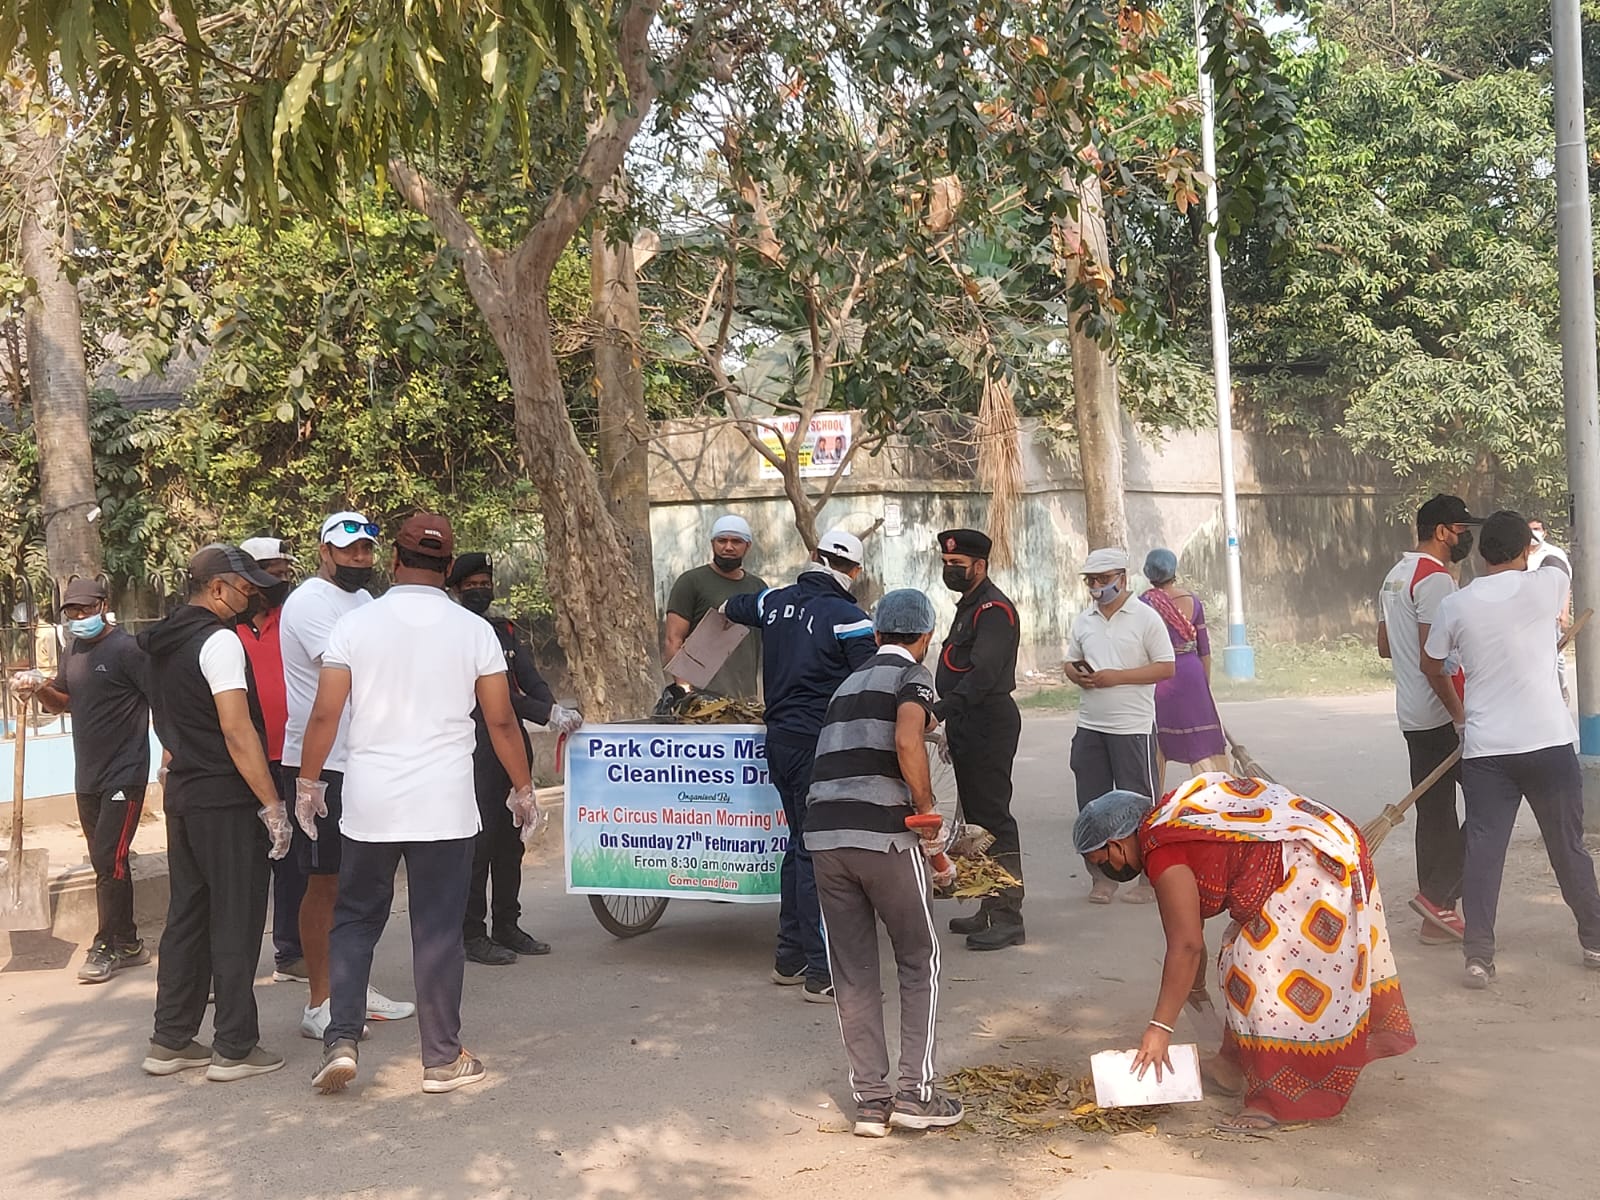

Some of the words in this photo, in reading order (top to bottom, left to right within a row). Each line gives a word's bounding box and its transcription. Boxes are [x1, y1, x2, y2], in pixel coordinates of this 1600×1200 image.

[811, 419, 844, 432] SCHOOL
[589, 739, 642, 758] Park
[650, 739, 725, 759] Circus
[607, 765, 734, 784] Cleanliness
[677, 791, 717, 803] Organised
[578, 807, 609, 823] Park
[613, 807, 658, 824] Circus
[662, 808, 712, 825] Maidan
[716, 810, 772, 831] Morning
[600, 833, 618, 848] On
[621, 834, 673, 850] Sunday
[676, 831, 703, 850] 27th
[705, 836, 768, 854] February,
[634, 856, 667, 868] From
[671, 857, 698, 869] 8:30
[701, 860, 719, 870] am
[721, 860, 776, 872] onwards
[669, 875, 698, 886] Come
[702, 878, 719, 888] and
[720, 877, 738, 889] Join
